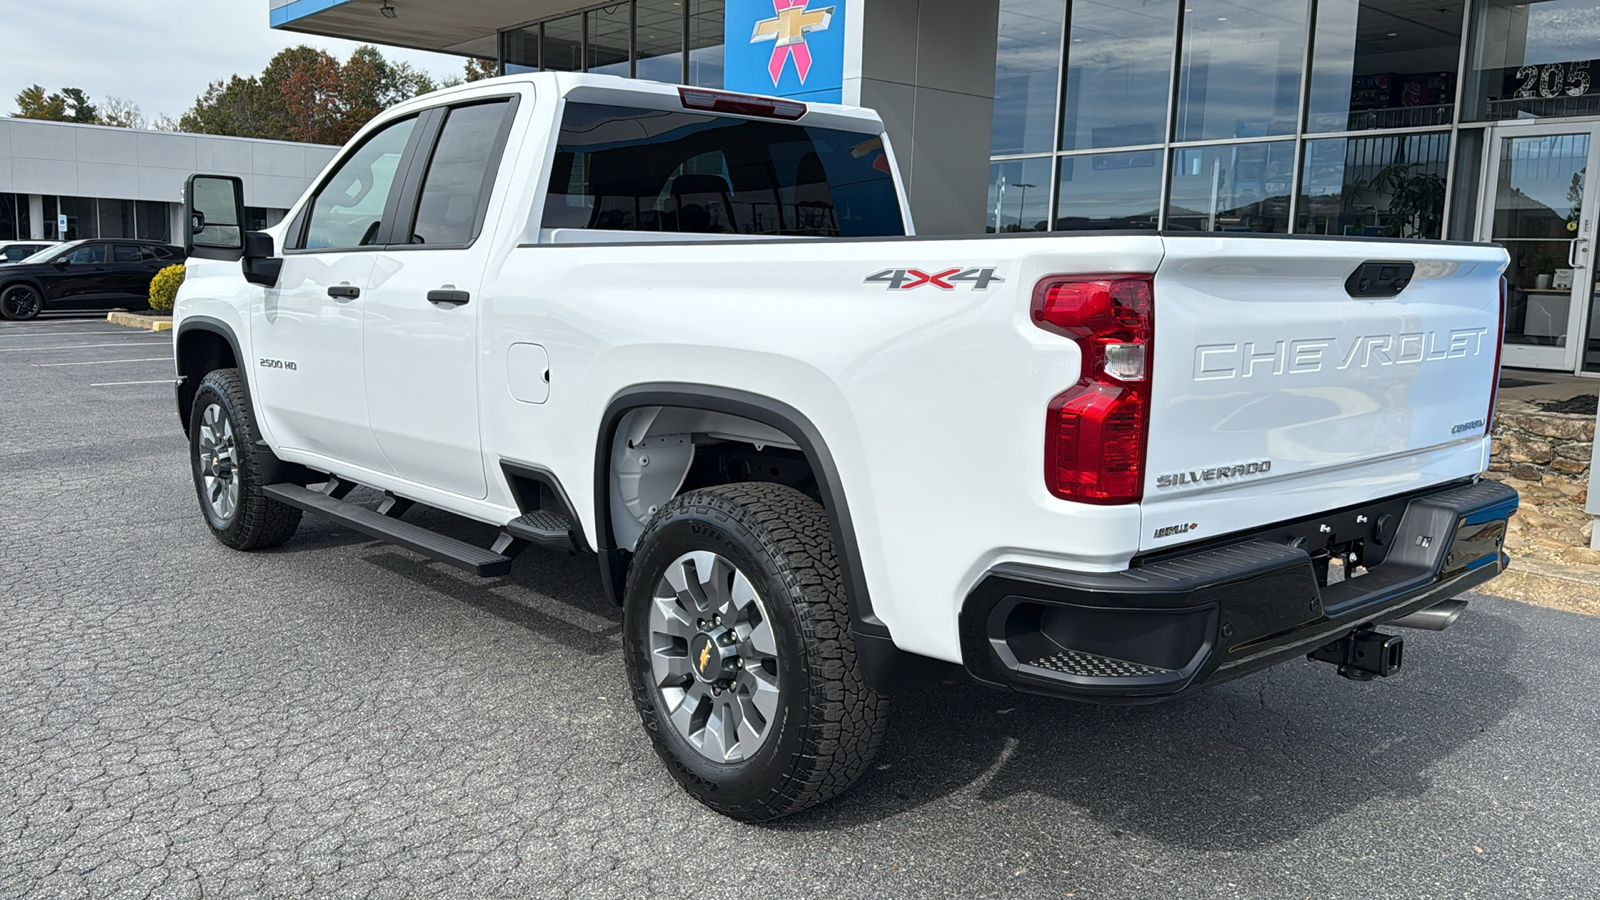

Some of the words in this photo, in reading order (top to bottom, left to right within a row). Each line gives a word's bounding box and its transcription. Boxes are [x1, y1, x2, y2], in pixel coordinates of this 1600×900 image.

[1513, 60, 1591, 99] 205
[260, 358, 282, 369] 2500
[284, 361, 297, 370] HD
[1193, 327, 1488, 382] CHEVROLET
[1156, 460, 1272, 488] SILVERADO
